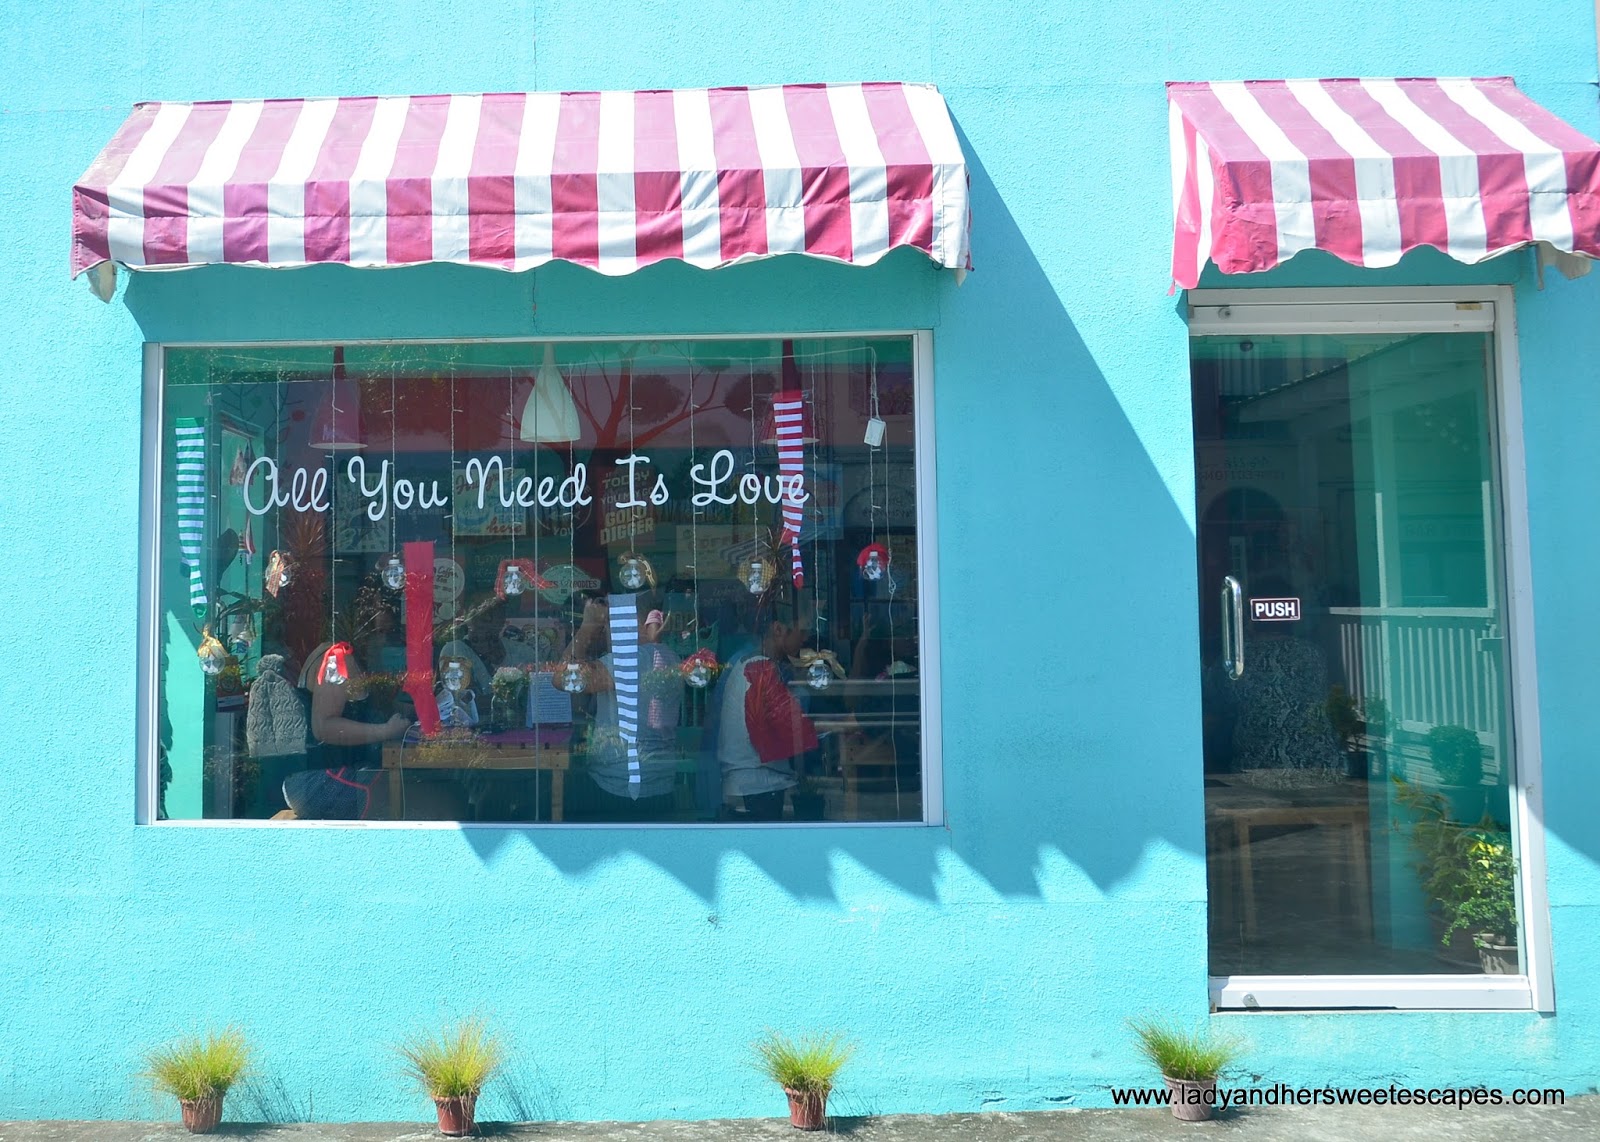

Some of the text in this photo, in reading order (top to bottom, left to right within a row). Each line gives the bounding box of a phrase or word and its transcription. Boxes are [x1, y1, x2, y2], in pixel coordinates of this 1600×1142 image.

[243, 449, 810, 522] All You Need Is Love
[623, 489, 641, 501] MY
[605, 506, 648, 527] GOLD
[600, 517, 655, 545] DIGGER
[1255, 602, 1296, 617] PUSH
